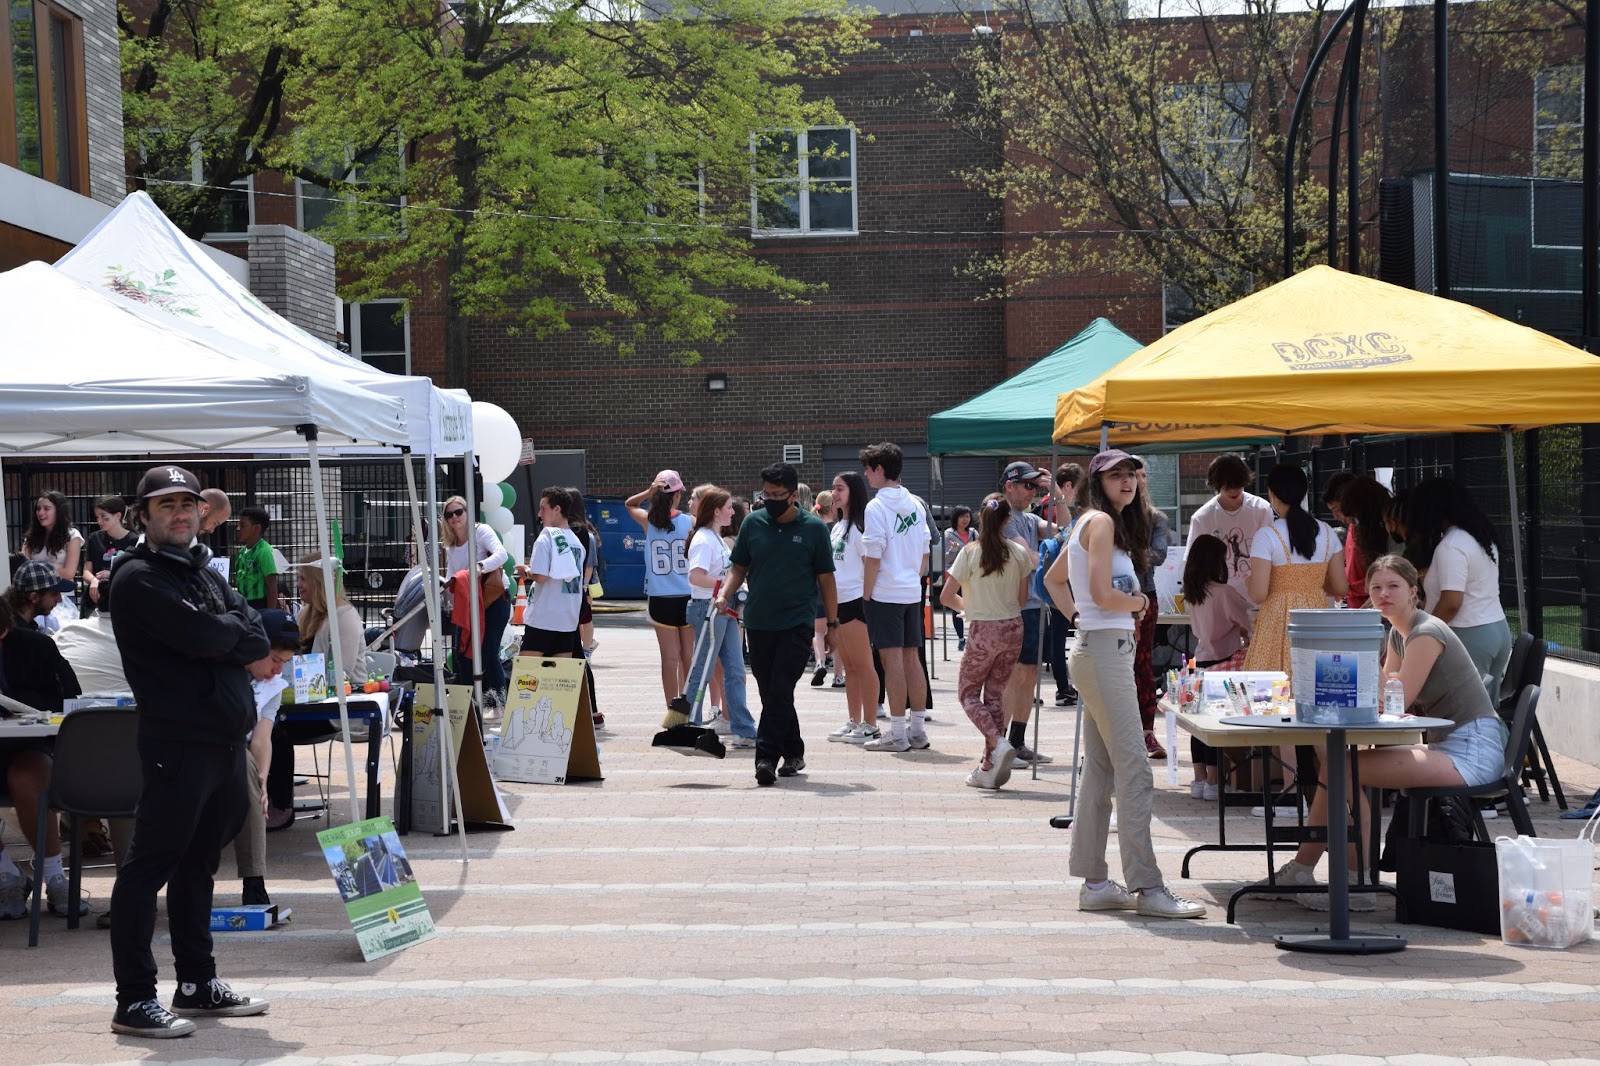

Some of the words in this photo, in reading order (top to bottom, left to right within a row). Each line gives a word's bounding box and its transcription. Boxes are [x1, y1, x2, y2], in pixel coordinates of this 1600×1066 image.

[167, 468, 186, 484] LA
[651, 539, 691, 575] 66
[517, 679, 537, 689] Post-it
[1323, 672, 1350, 683] 200
[321, 835, 331, 845] WE
[331, 831, 345, 842] HAVE
[344, 826, 362, 839] SOLAR
